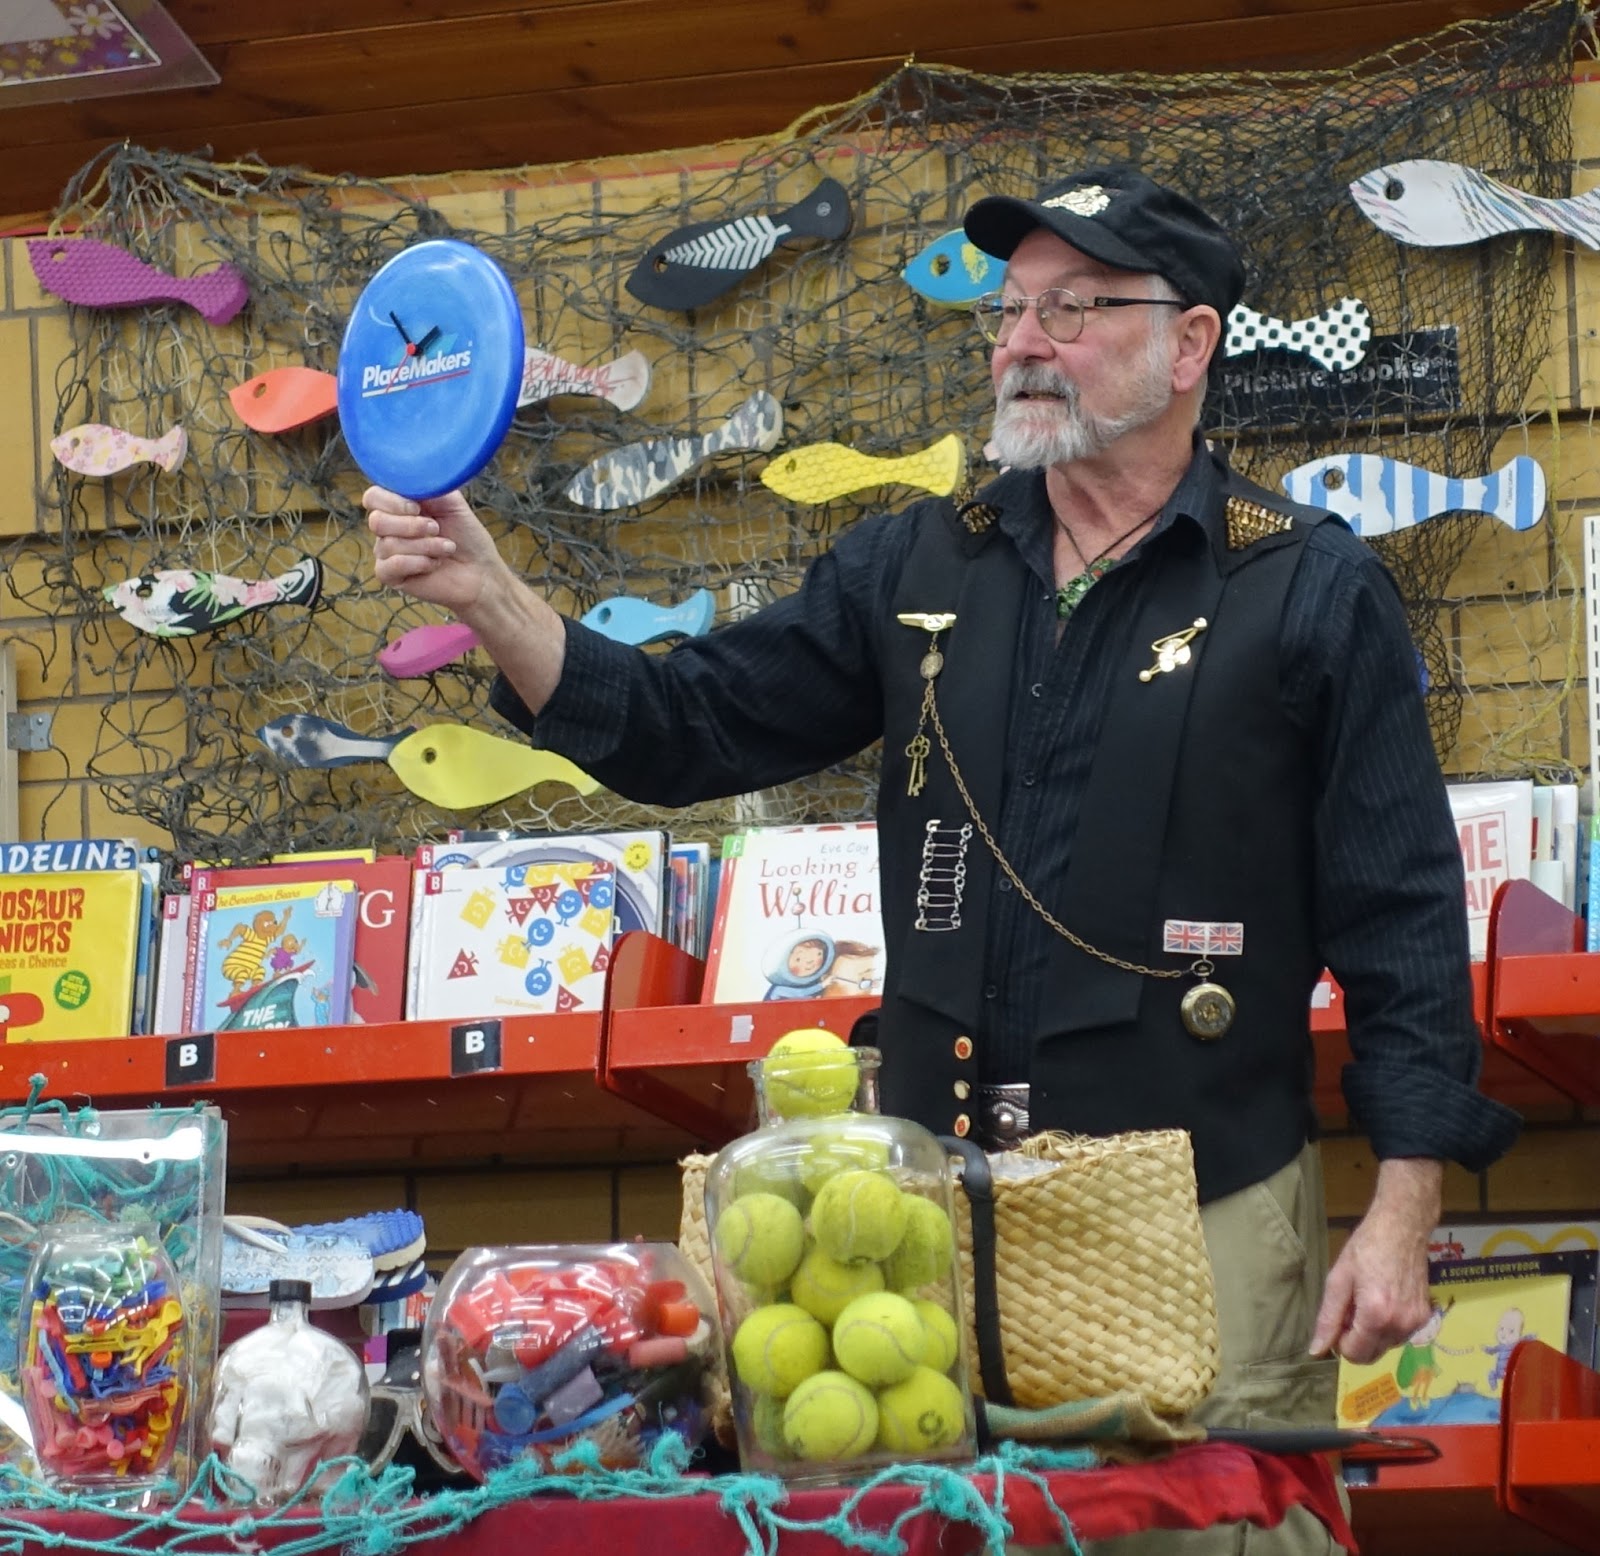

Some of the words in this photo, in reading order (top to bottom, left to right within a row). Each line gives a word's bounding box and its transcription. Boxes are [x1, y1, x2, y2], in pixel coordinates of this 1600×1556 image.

[363, 350, 471, 389] PlaceMakers
[0, 842, 133, 874] DELINE
[422, 851, 431, 866] B
[760, 857, 858, 879] Looking
[183, 864, 192, 879] B
[198, 876, 207, 891] B
[431, 876, 441, 891] B
[0, 887, 85, 921] OSAUR
[168, 900, 177, 915] B
[206, 893, 216, 908] B
[358, 888, 396, 929] G
[758, 878, 880, 919] Willia
[28, 955, 67, 970] Chance
[242, 1004, 278, 1027] THE
[465, 1030, 486, 1055] B
[179, 1043, 198, 1068] B
[1440, 1268, 1448, 1278] A
[1449, 1264, 1486, 1277] SCIENCE
[1488, 1261, 1541, 1274] STORYBOOK
